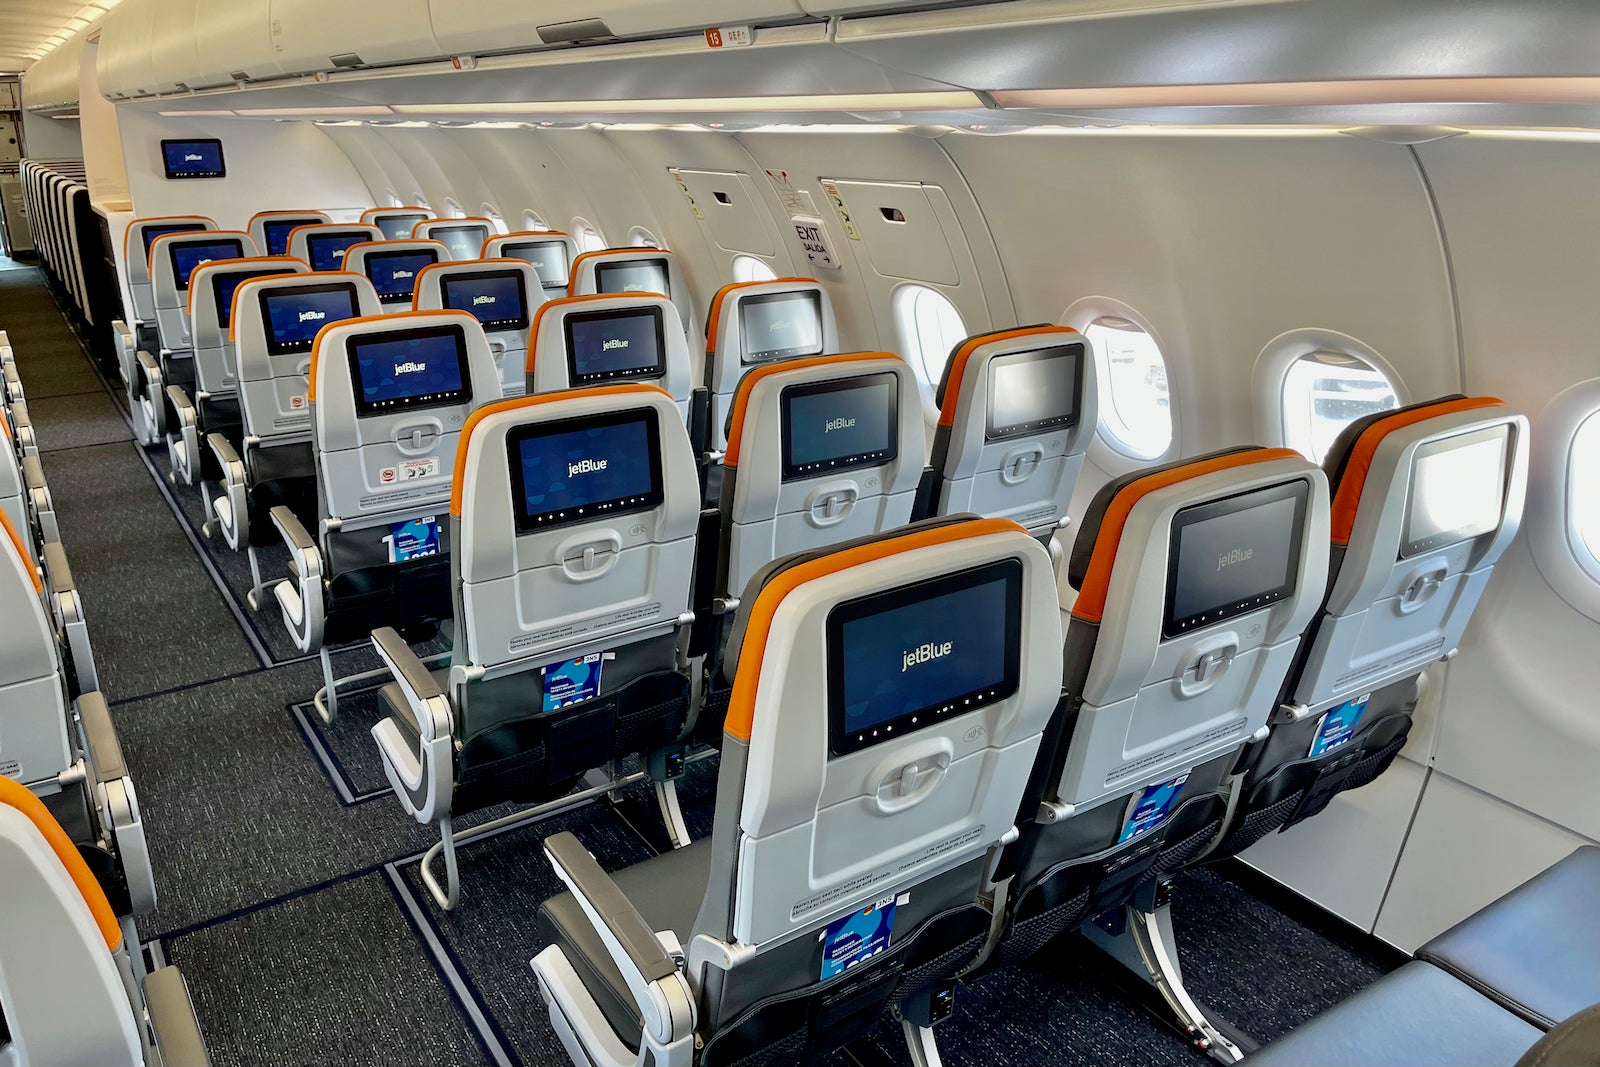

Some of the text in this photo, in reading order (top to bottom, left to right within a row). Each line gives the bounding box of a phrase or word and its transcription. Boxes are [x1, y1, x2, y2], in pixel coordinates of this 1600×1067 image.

[709, 32, 720, 45] 15
[796, 226, 820, 241] EXIT
[803, 243, 826, 253] SALIDA
[473, 296, 496, 306] jetBlue
[299, 311, 325, 322] jetBlue
[602, 339, 629, 351] jetBlue
[394, 361, 426, 376] jetBlue
[825, 417, 856, 433] jetBlue
[568, 459, 607, 478] jetBlue
[1216, 548, 1253, 572] jetBlue
[901, 641, 952, 672] jetBlue
